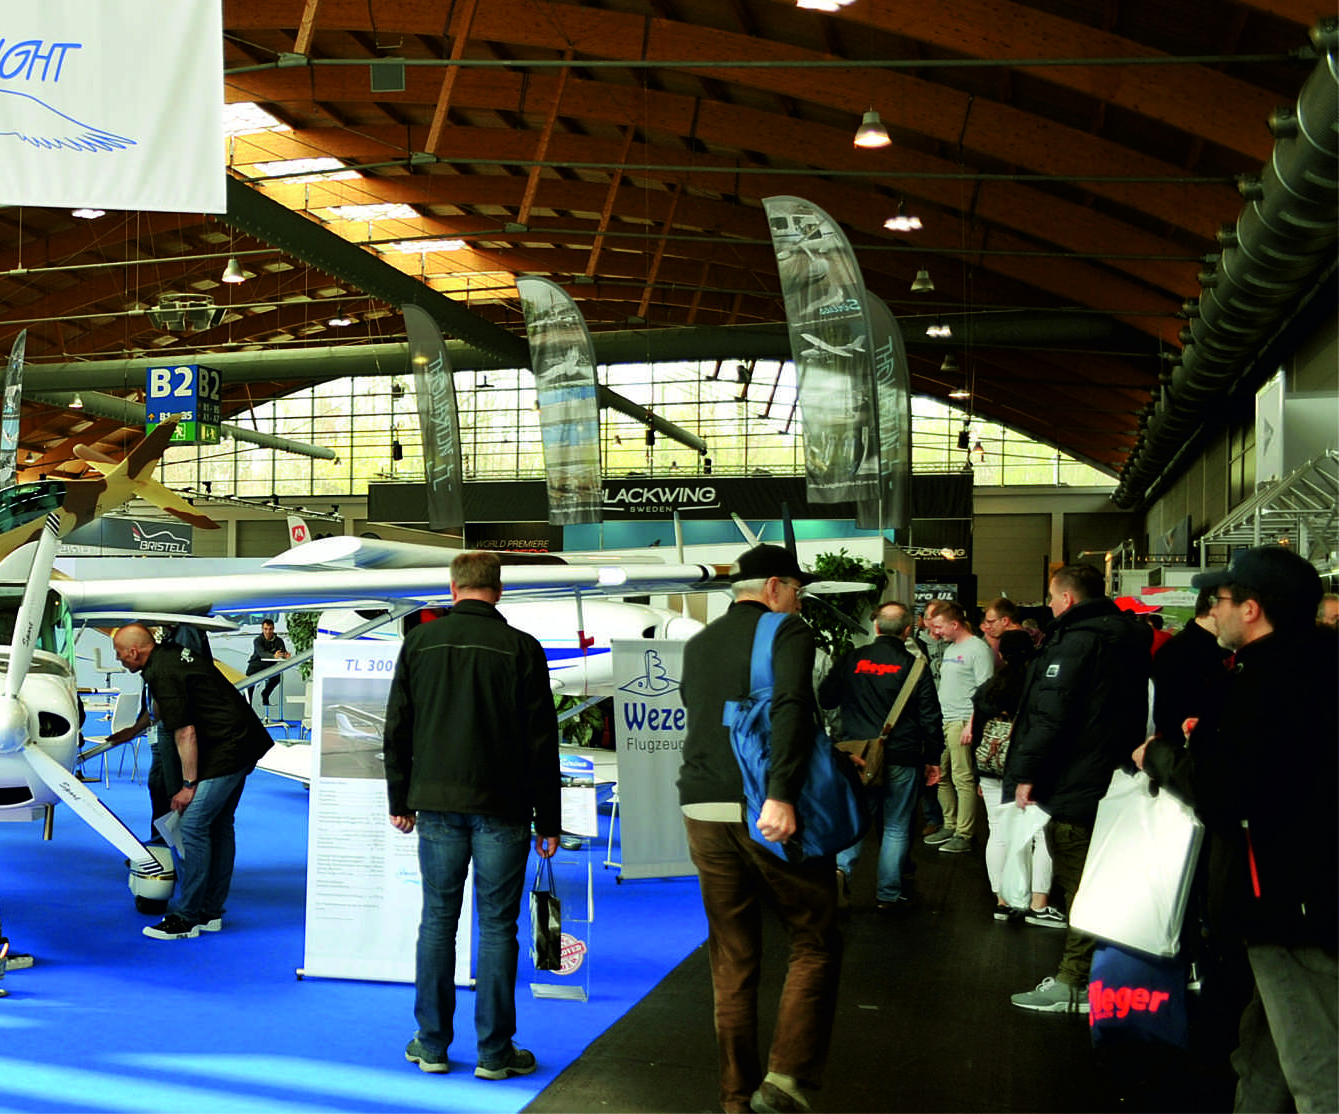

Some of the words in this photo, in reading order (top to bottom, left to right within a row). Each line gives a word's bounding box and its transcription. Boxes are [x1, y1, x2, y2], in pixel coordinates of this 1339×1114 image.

[150, 366, 193, 398] B2
[198, 367, 220, 401] B2
[602, 487, 716, 504] LACKWING
[139, 540, 188, 553] BRISTELL
[507, 539, 550, 548] PREMIERE
[345, 659, 363, 671] TL
[367, 659, 395, 672] 300
[624, 702, 686, 731] Weze
[627, 737, 685, 754] Flugzeug
